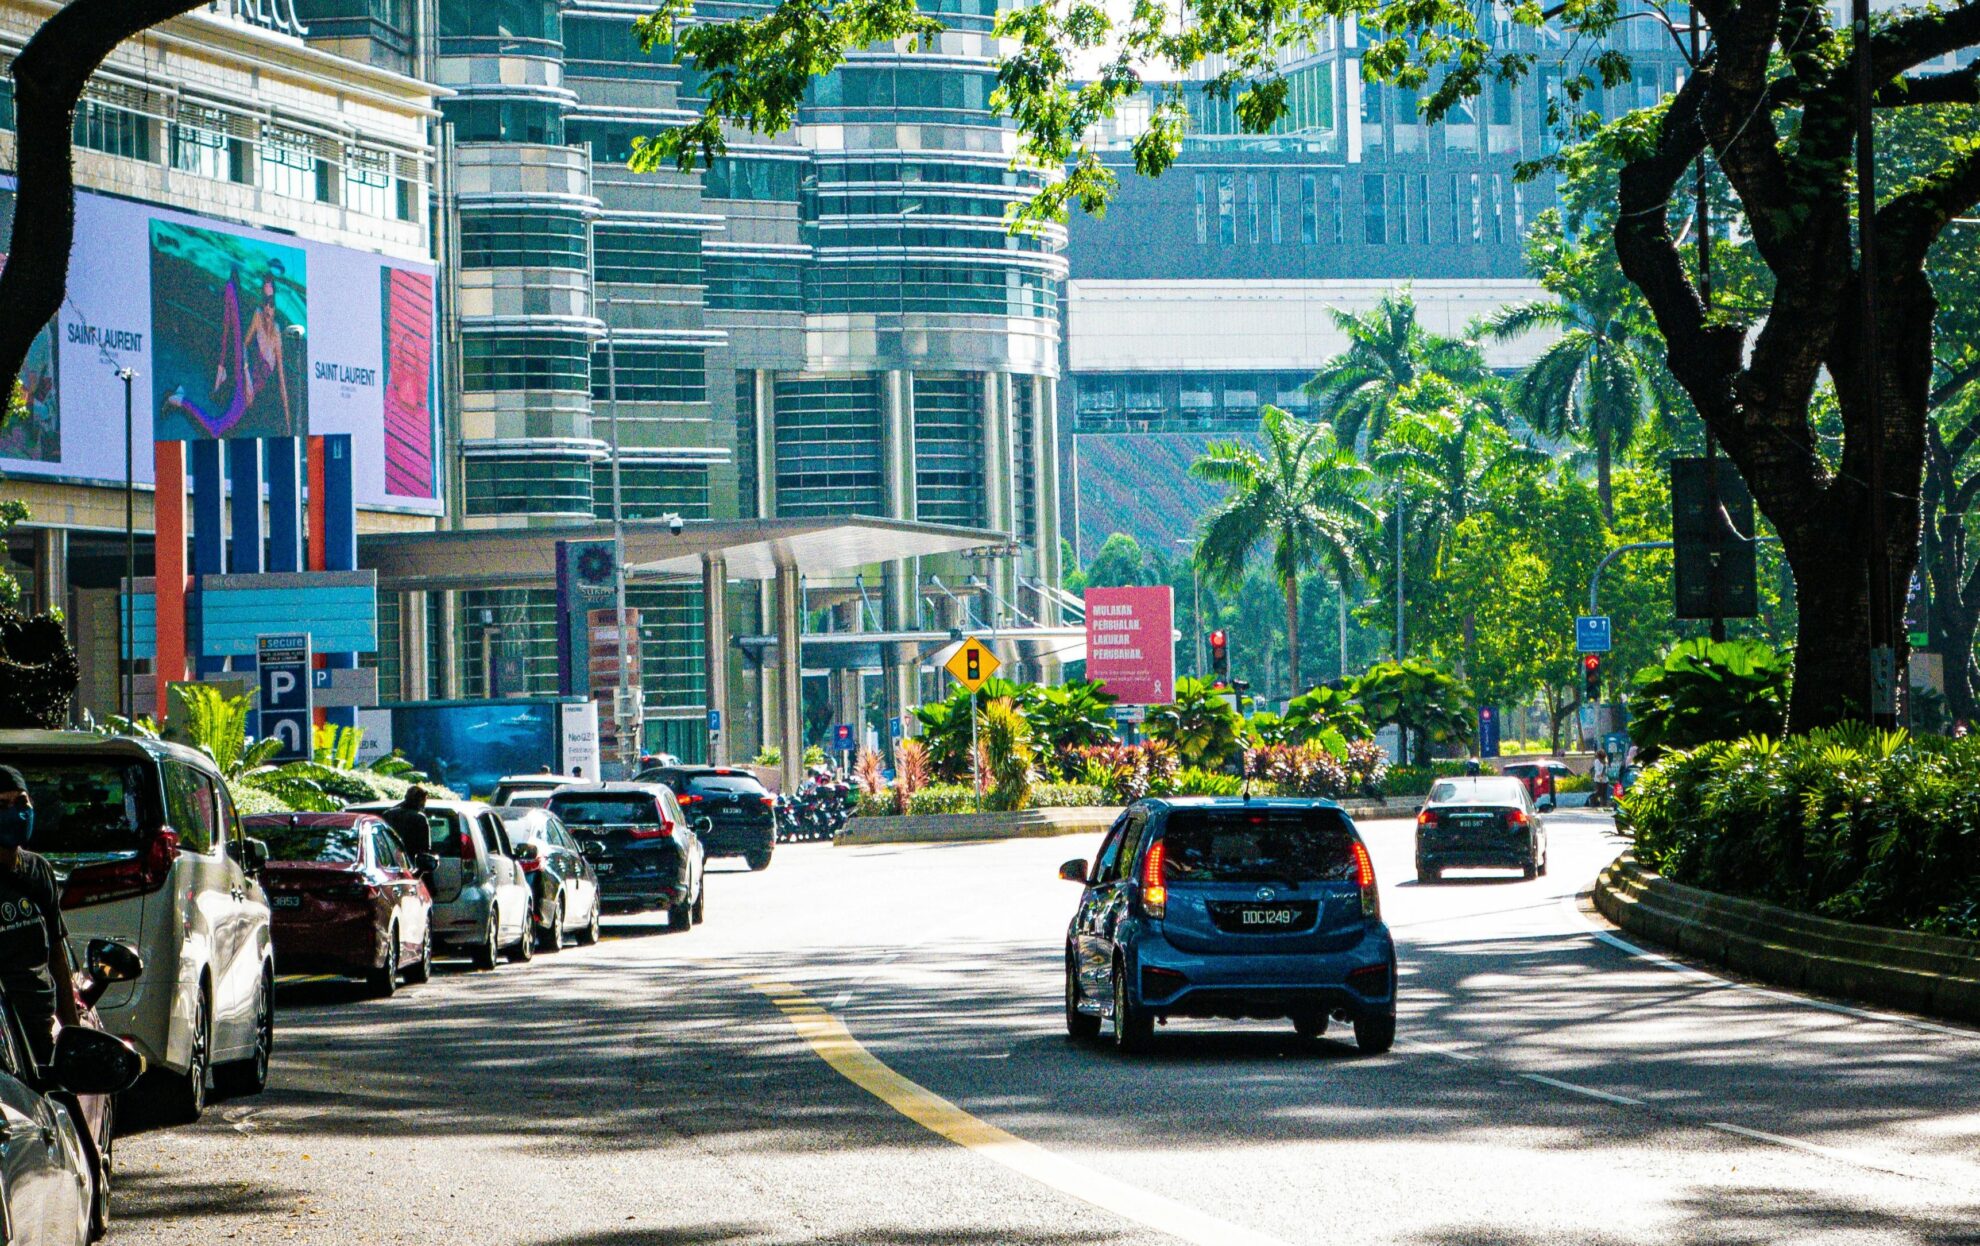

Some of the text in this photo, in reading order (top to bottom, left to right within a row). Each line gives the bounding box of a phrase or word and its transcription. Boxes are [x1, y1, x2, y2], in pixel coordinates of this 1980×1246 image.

[67, 323, 142, 352] SAINT LAURENT
[315, 361, 375, 386] SAINT LAURENT
[267, 638, 303, 648] secure
[271, 671, 296, 704] P
[317, 672, 327, 687] P
[711, 713, 718, 726] P
